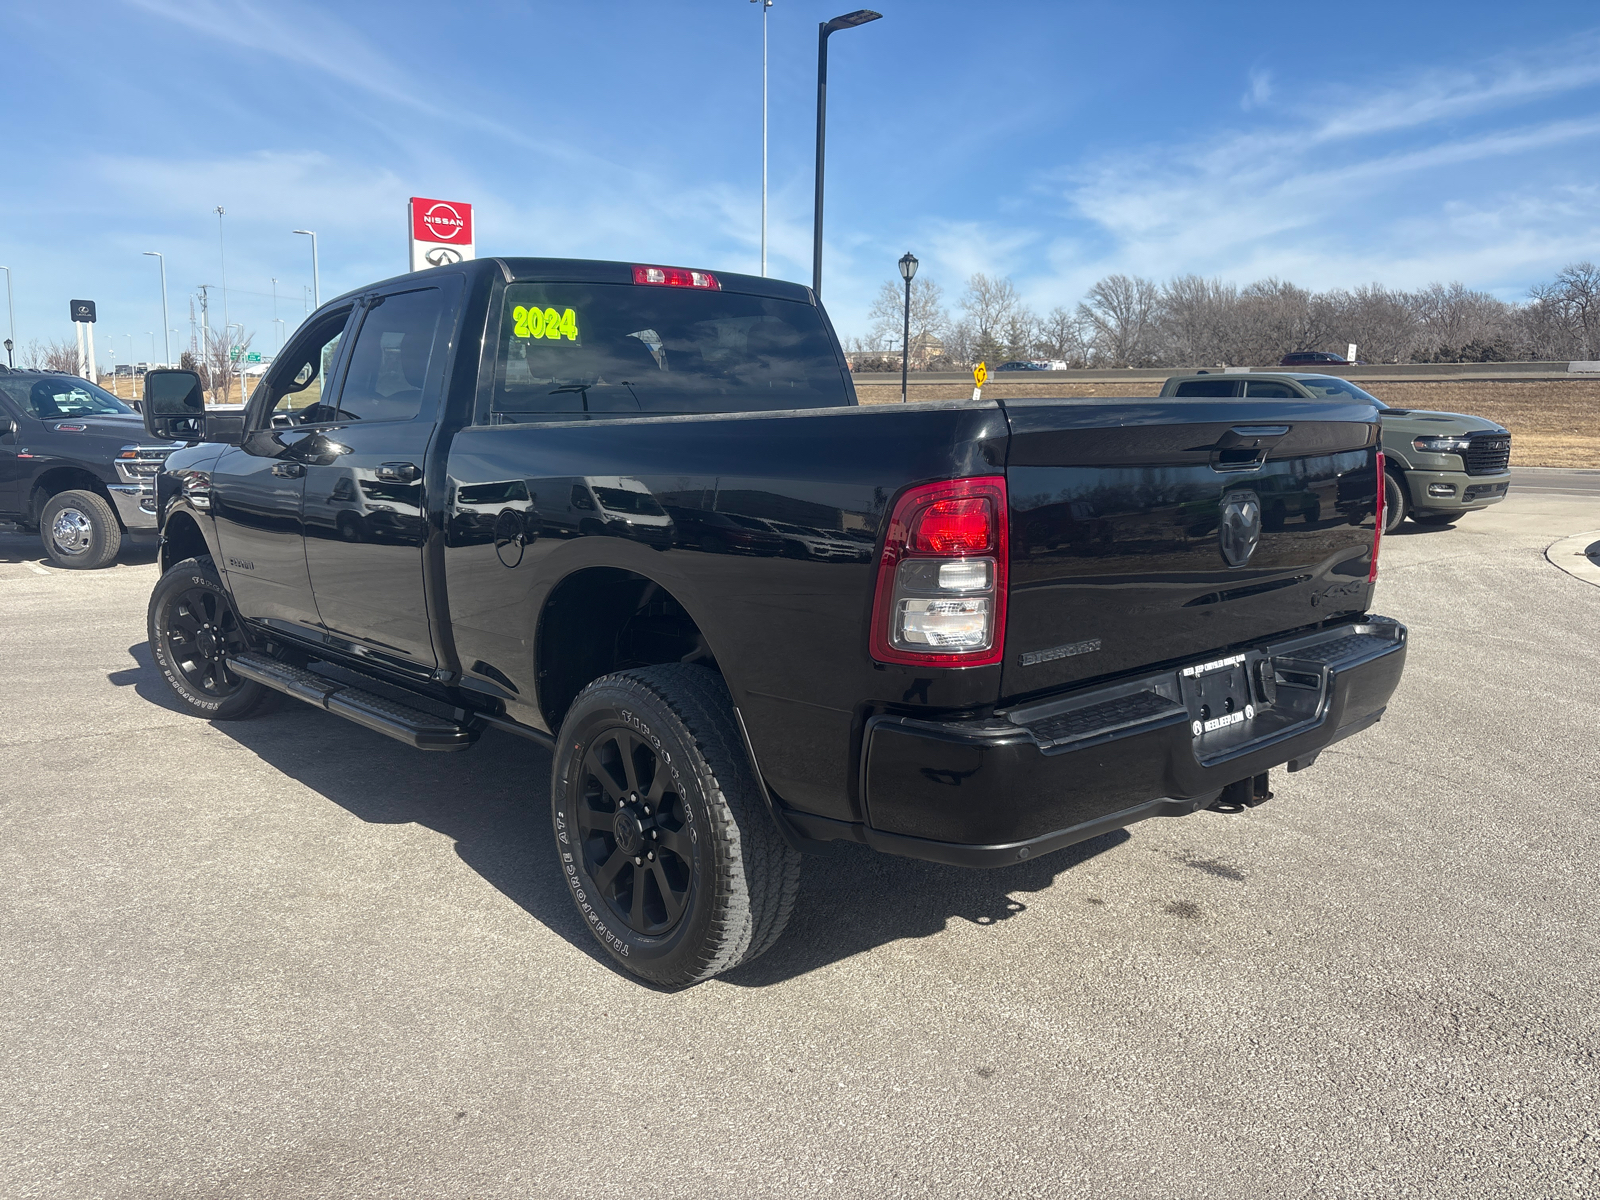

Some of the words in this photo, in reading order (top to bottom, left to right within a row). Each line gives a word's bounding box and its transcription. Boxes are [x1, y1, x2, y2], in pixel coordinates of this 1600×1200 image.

[423, 216, 463, 227] NISSAN
[513, 305, 578, 341] 2024
[164, 669, 219, 710] TRANSFORCE
[1204, 711, 1244, 732] REEDJEEP.COM
[565, 852, 631, 958] TRANSFORCE
